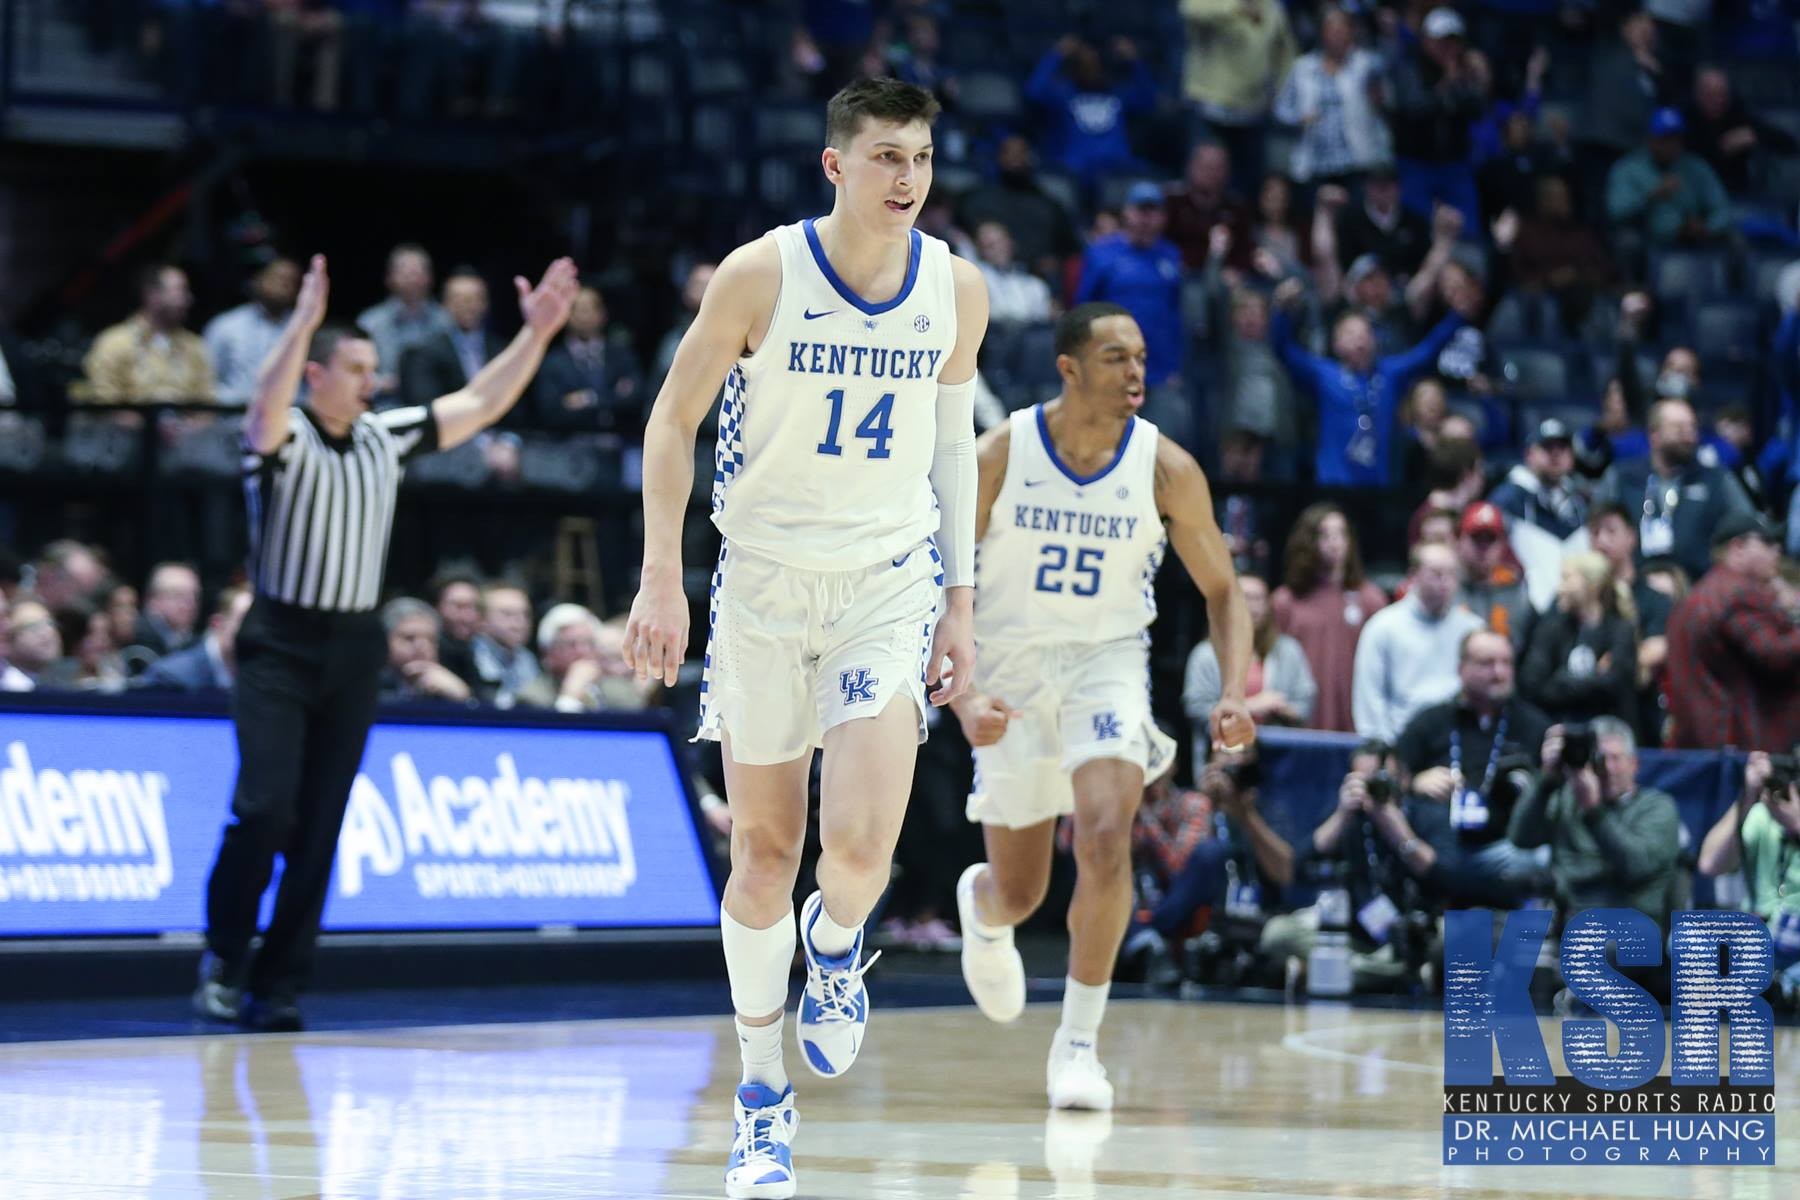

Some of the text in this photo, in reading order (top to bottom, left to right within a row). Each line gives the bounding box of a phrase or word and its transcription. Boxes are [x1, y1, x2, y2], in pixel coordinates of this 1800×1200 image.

[788, 342, 942, 379] KENTUCKY
[817, 389, 895, 459] 14
[1014, 504, 1138, 539] KENTUCKY
[1035, 544, 1105, 597] 25
[839, 667, 879, 706] UK
[391, 752, 638, 886] Academy
